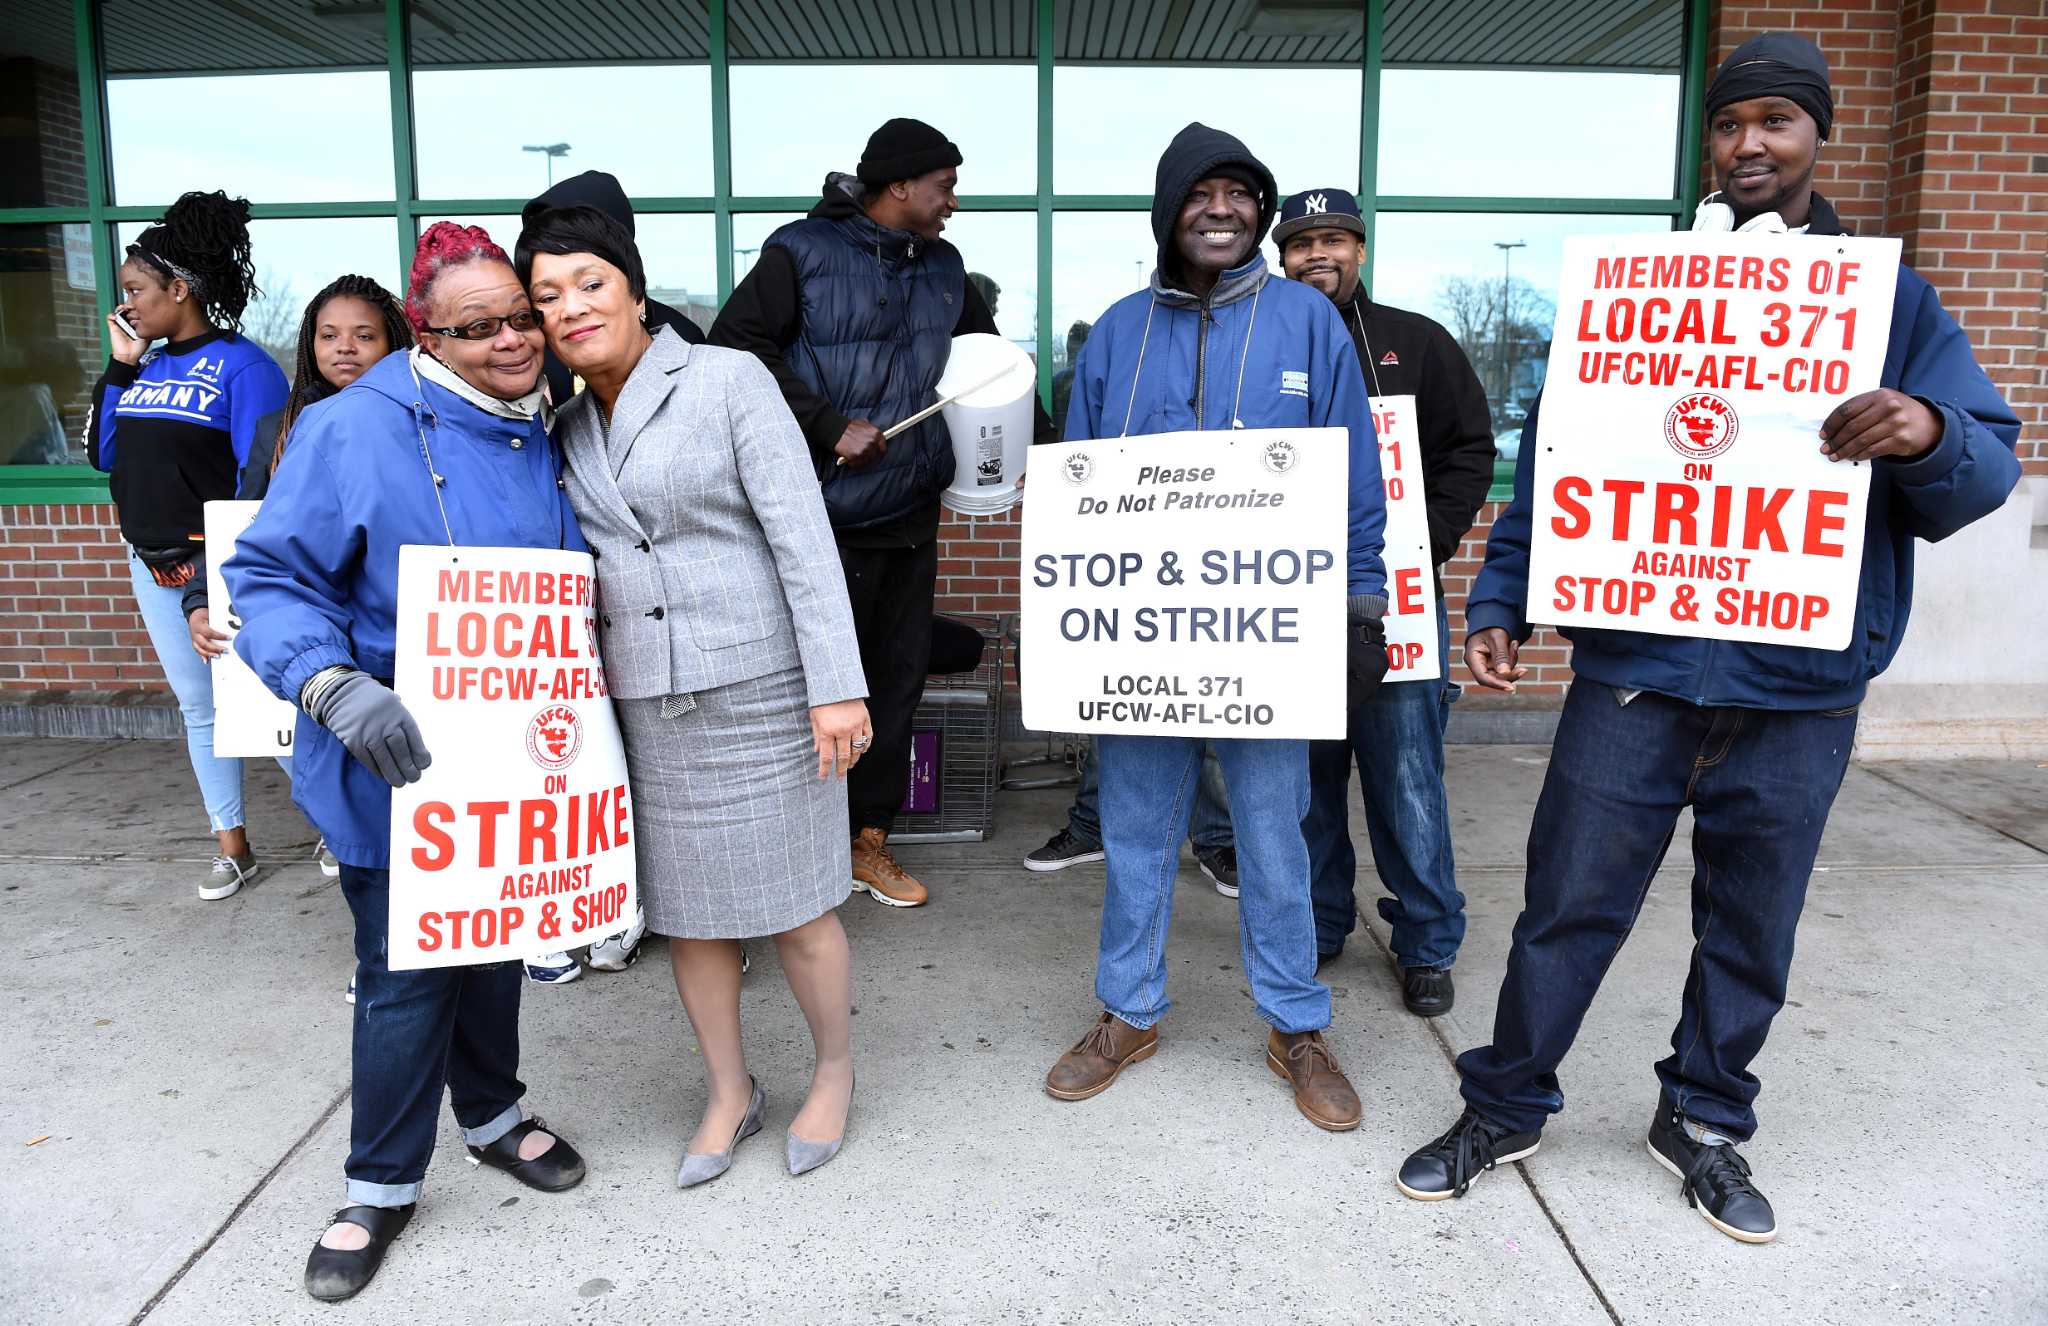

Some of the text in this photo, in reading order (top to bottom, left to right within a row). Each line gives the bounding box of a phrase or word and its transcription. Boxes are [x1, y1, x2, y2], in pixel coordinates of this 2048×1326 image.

[1595, 255, 1860, 295] MEMBERS OF
[1578, 298, 1856, 350] LOCAL 371
[1579, 352, 1849, 394] UFCW-AFL-CIO
[1677, 396, 1728, 415] UFCW
[1138, 466, 1214, 485] Please
[1684, 464, 1712, 481] ON
[1078, 492, 1283, 514] Do Not Patronize
[1551, 476, 1849, 558] STRIKE
[1034, 550, 1333, 587] STOP & SHOP
[1632, 551, 1751, 582] AGAINST
[438, 570, 591, 606] MEMBERS
[1553, 575, 1829, 631] STOP & SHOP
[428, 612, 578, 658] LOCAL
[1061, 608, 1298, 642] ON STRIKE
[1104, 676, 1241, 696] LOCAL 371
[535, 707, 576, 727] UFCW
[1079, 701, 1273, 725] UFCW-AFL-CIO
[545, 775, 566, 794] ON
[411, 784, 629, 872] STRIKE
[500, 864, 593, 900] AGAINST
[418, 882, 627, 952] STOP & SHOP
